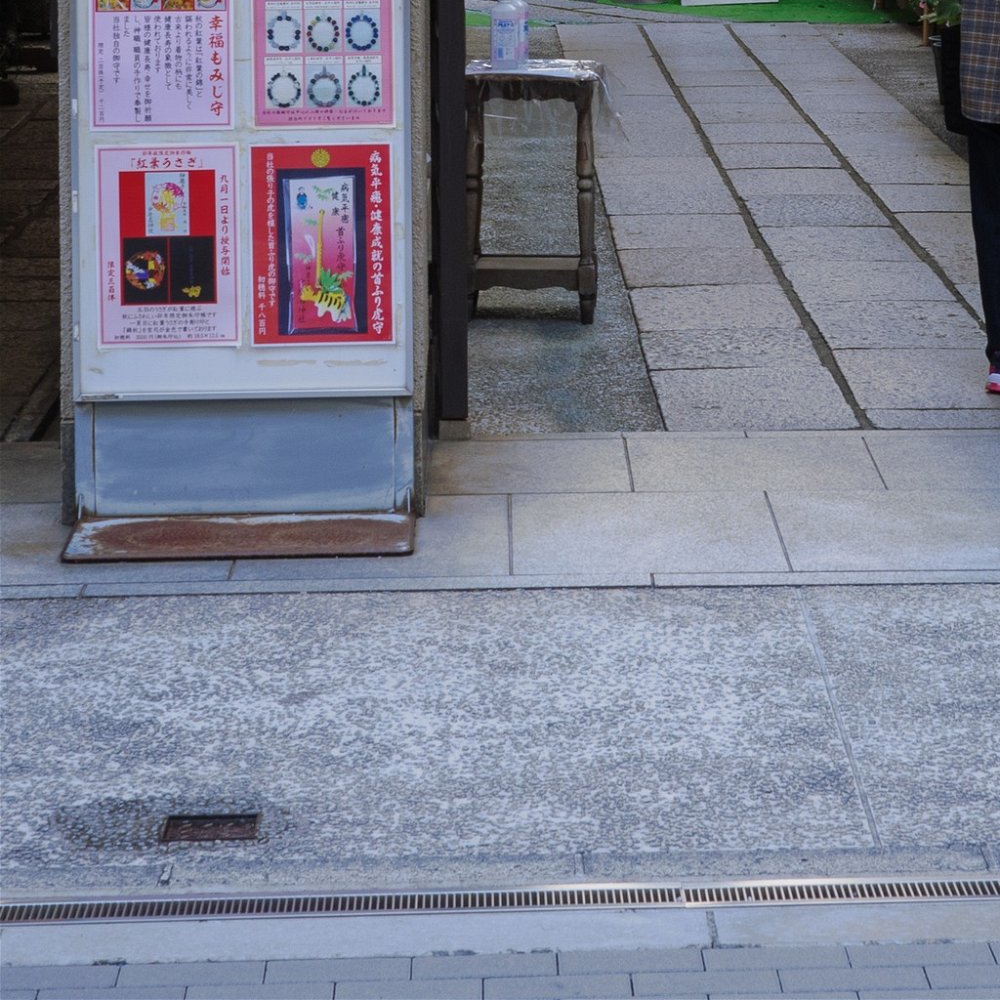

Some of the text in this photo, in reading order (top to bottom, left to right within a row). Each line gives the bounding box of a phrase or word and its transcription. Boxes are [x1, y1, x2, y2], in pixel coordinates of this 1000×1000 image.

[209, 15, 224, 116] 幸福もみじ守
